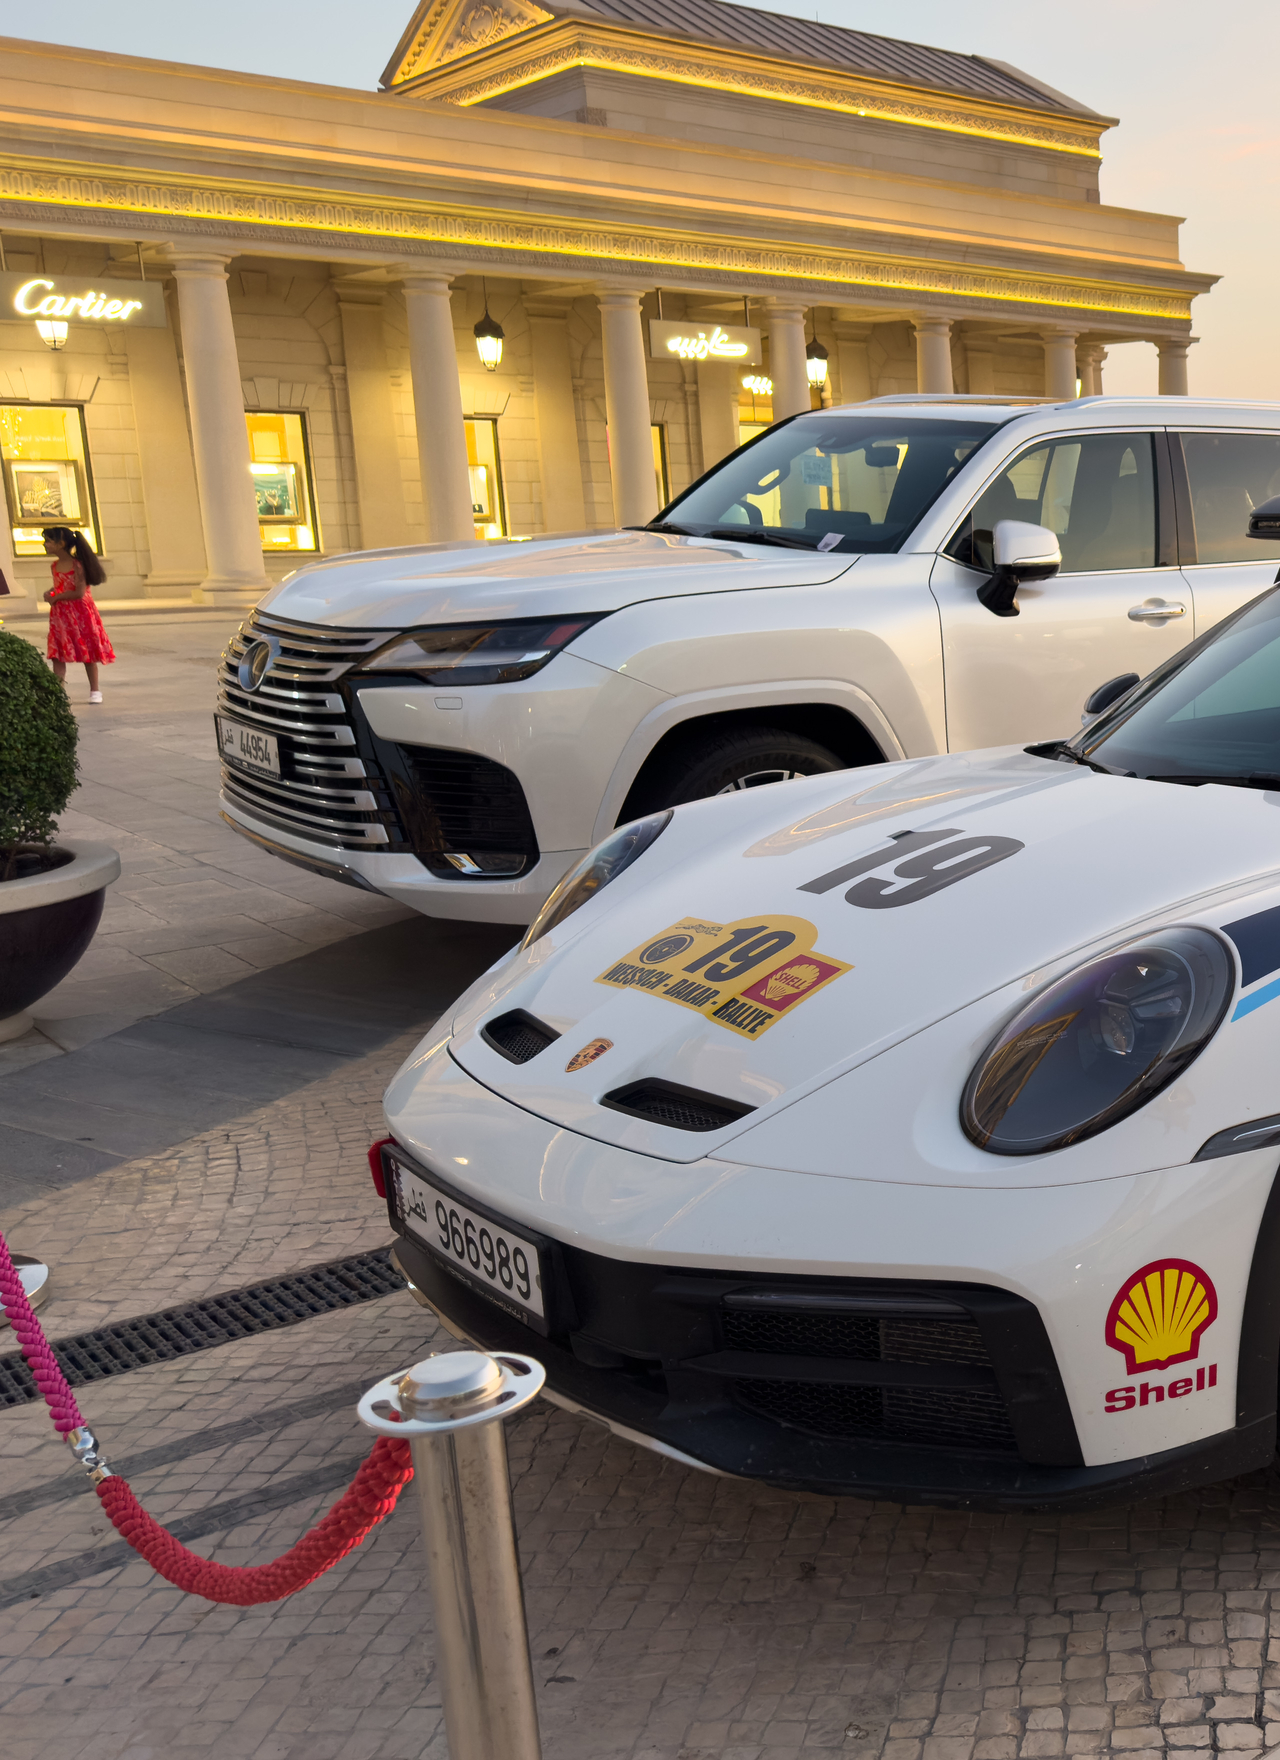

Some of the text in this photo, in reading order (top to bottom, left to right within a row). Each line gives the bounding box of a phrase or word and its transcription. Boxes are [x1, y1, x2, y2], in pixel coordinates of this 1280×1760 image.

[14, 278, 143, 320] Cartier
[224, 728, 234, 746] قطر
[240, 730, 271, 766] 44954
[796, 828, 1026, 910] 19
[682, 925, 796, 983] 19
[602, 962, 673, 991] WEISSACH
[711, 997, 775, 1034] RALLYE
[775, 972, 807, 990] SHELL
[405, 1187, 428, 1223] قطر
[434, 1199, 531, 1301] 966989
[1104, 1363, 1218, 1414] Shell
